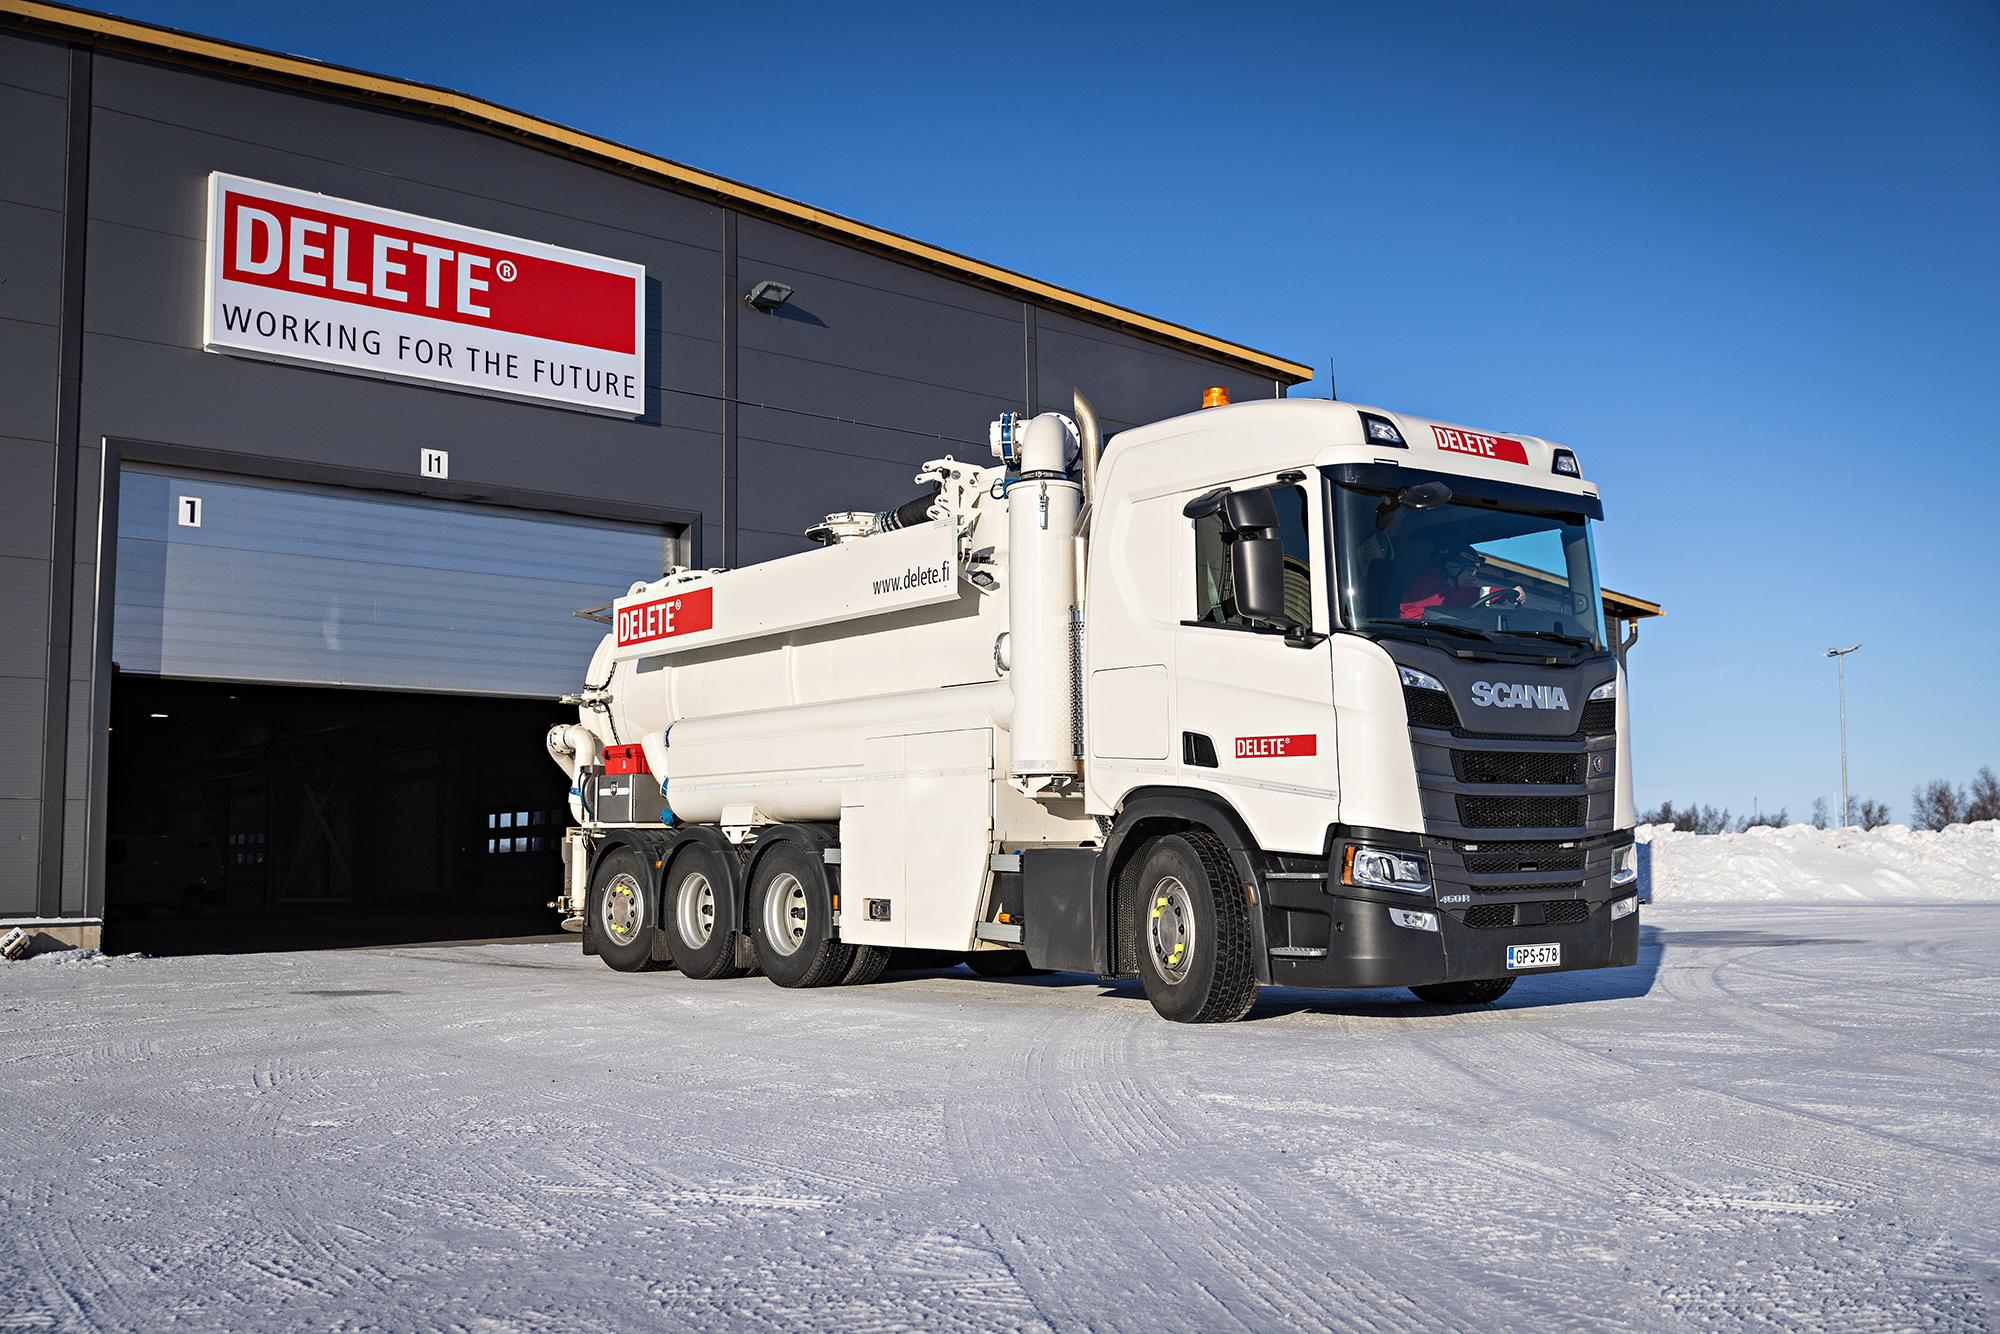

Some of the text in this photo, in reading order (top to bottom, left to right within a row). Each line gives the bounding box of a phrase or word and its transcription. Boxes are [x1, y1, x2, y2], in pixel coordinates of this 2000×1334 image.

[222, 303, 636, 400] WORKING FOR THE FUTURE
[185, 500, 196, 524] 1
[872, 560, 950, 595] www.delete.fi
[1471, 681, 1570, 711] SCANIA
[1516, 947, 1558, 965] GPS-578
